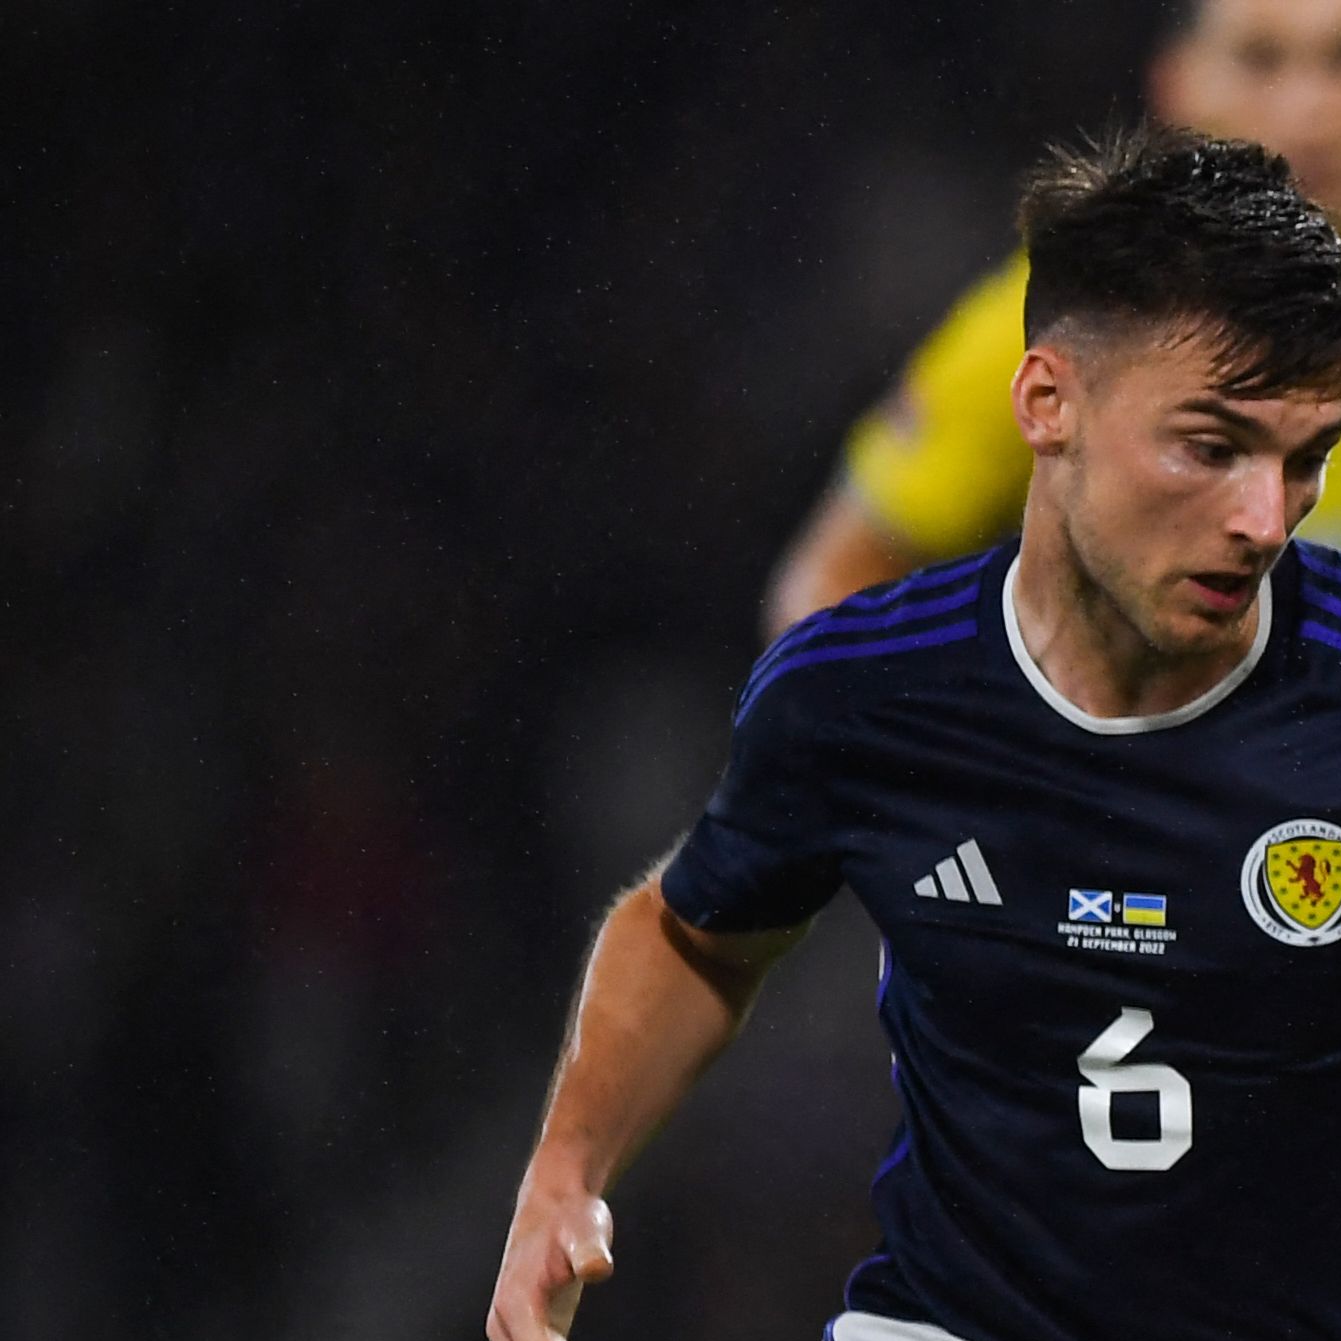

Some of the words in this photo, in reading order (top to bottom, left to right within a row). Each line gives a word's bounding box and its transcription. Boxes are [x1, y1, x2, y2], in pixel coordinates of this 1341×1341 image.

[1271, 824, 1337, 842] SCOTLAND
[1058, 922, 1102, 937] HAMPDEN
[1082, 938, 1136, 953] SEPTEMBER
[1139, 941, 1165, 955] 2022
[1077, 1006, 1193, 1171] 6
